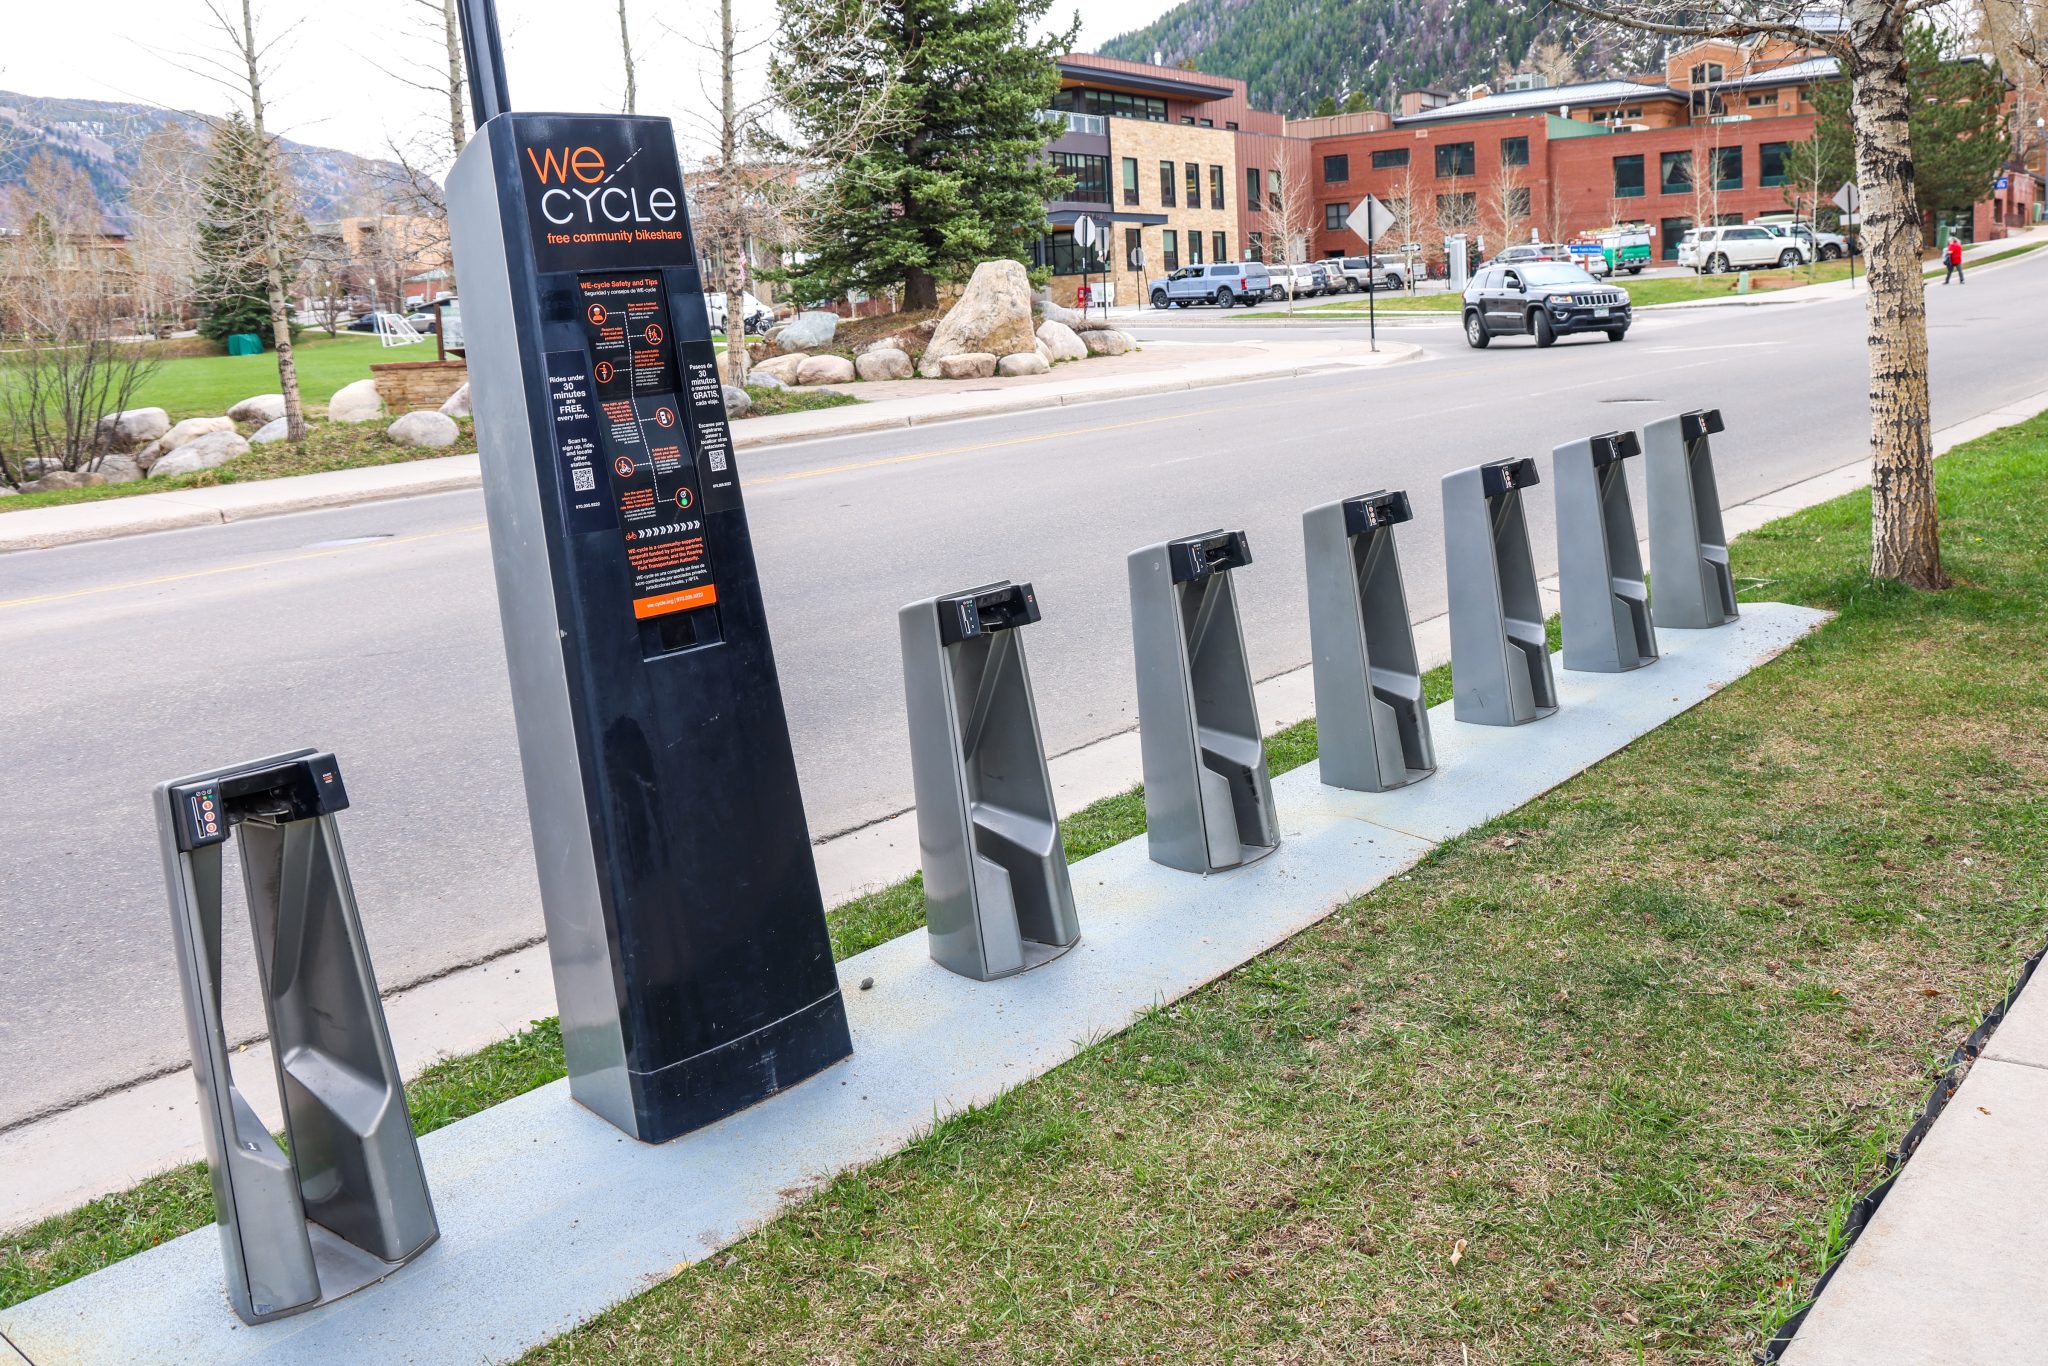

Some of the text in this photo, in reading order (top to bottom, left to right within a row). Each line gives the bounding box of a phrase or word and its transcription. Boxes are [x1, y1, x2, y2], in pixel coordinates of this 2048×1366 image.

[547, 229, 682, 244] free community bikeshare
[553, 390, 586, 400] minutes
[693, 390, 720, 400] GRATIS,
[560, 404, 585, 414] FREE,
